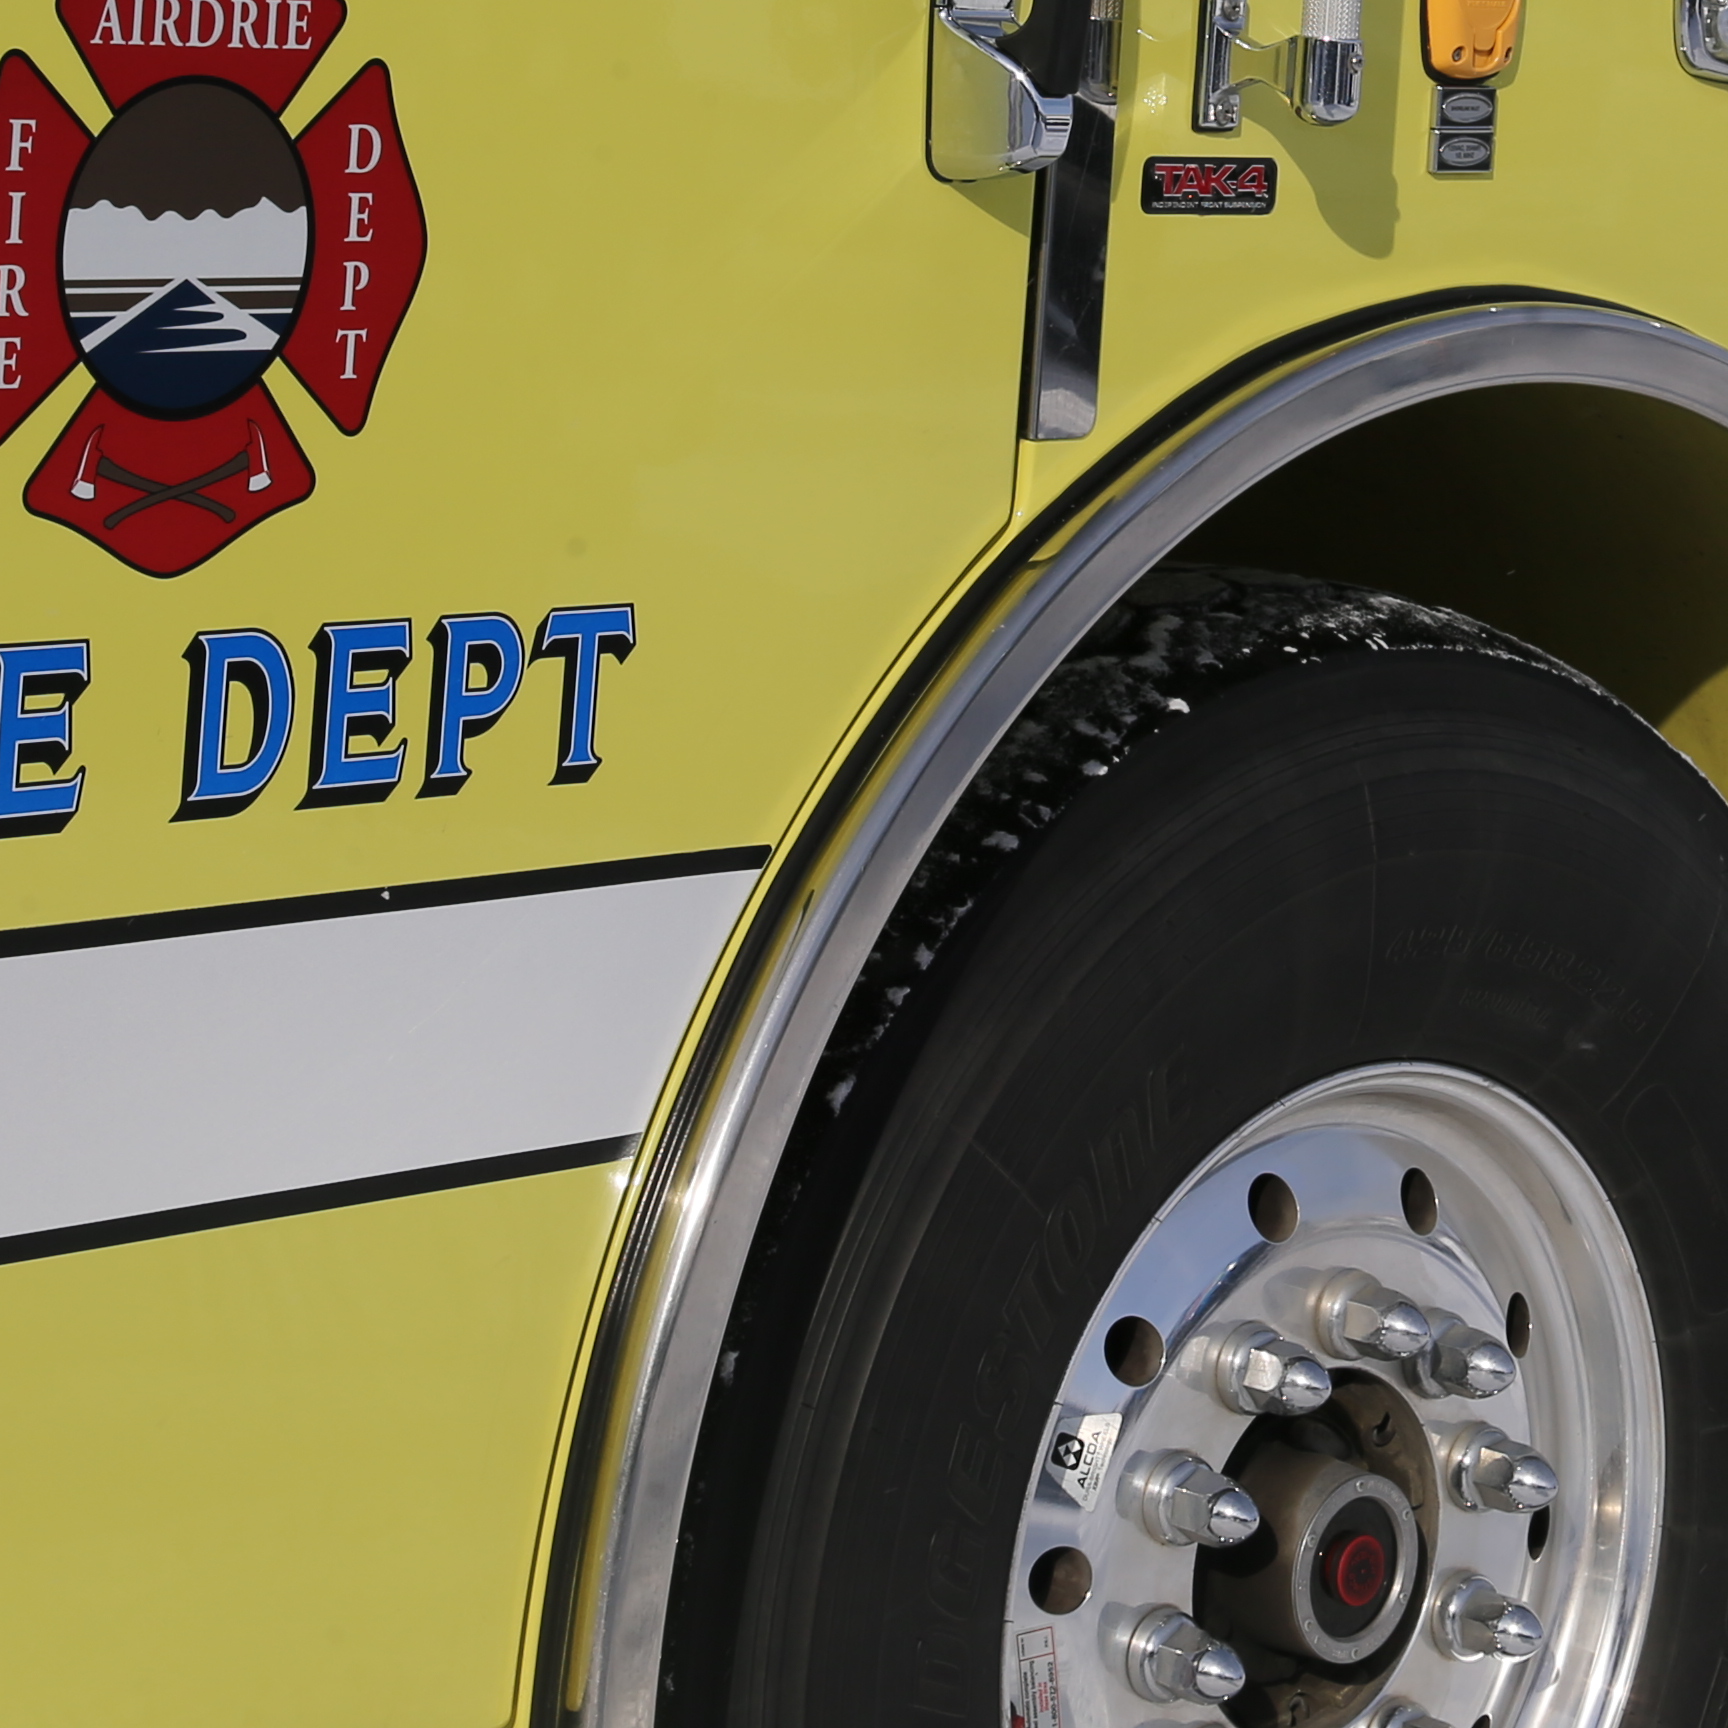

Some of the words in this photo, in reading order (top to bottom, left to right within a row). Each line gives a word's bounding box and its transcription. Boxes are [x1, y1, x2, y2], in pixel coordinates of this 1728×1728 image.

[1155, 163, 1268, 197] TAK-4
[1200, 201, 1223, 209] FRONT
[1224, 201, 1267, 209] SUSPENSION
[336, 122, 382, 381] DEPT
[170, 603, 636, 822] DEPT
[1077, 1430, 1102, 1489] ALCOA
